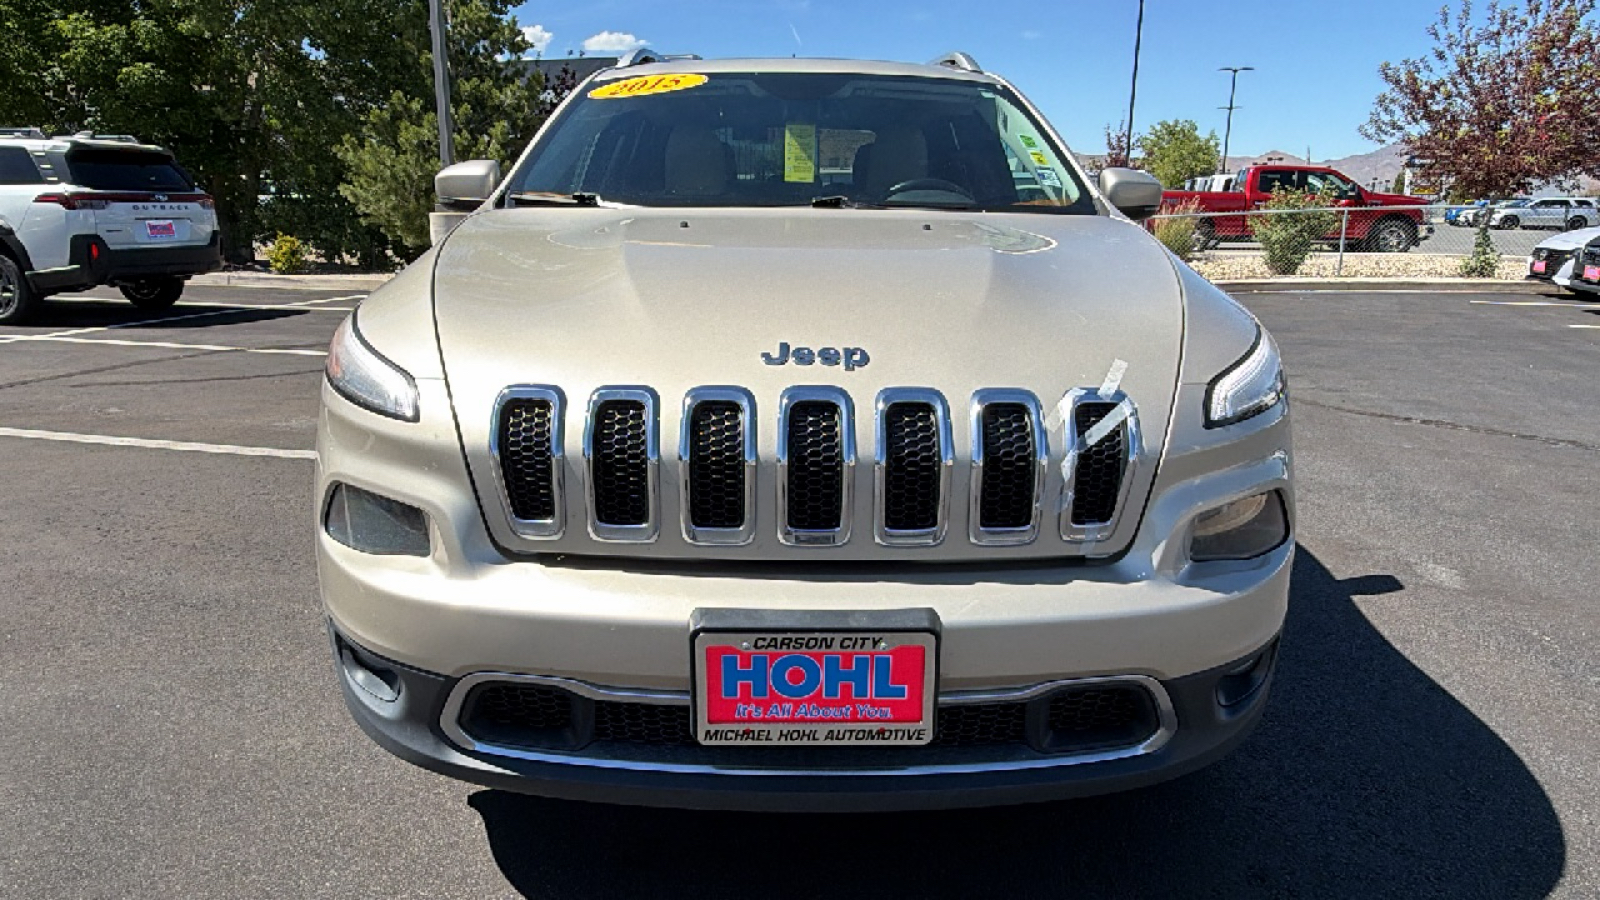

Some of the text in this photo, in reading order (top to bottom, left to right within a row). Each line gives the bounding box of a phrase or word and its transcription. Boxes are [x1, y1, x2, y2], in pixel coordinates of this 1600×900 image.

[760, 341, 870, 371] Jeep
[753, 637, 883, 650] CARSON CITY
[721, 654, 908, 699] HOHL
[735, 703, 893, 719] It's All About You.
[704, 728, 927, 742] MICHAEL HOHL AUTOMOTIVE
